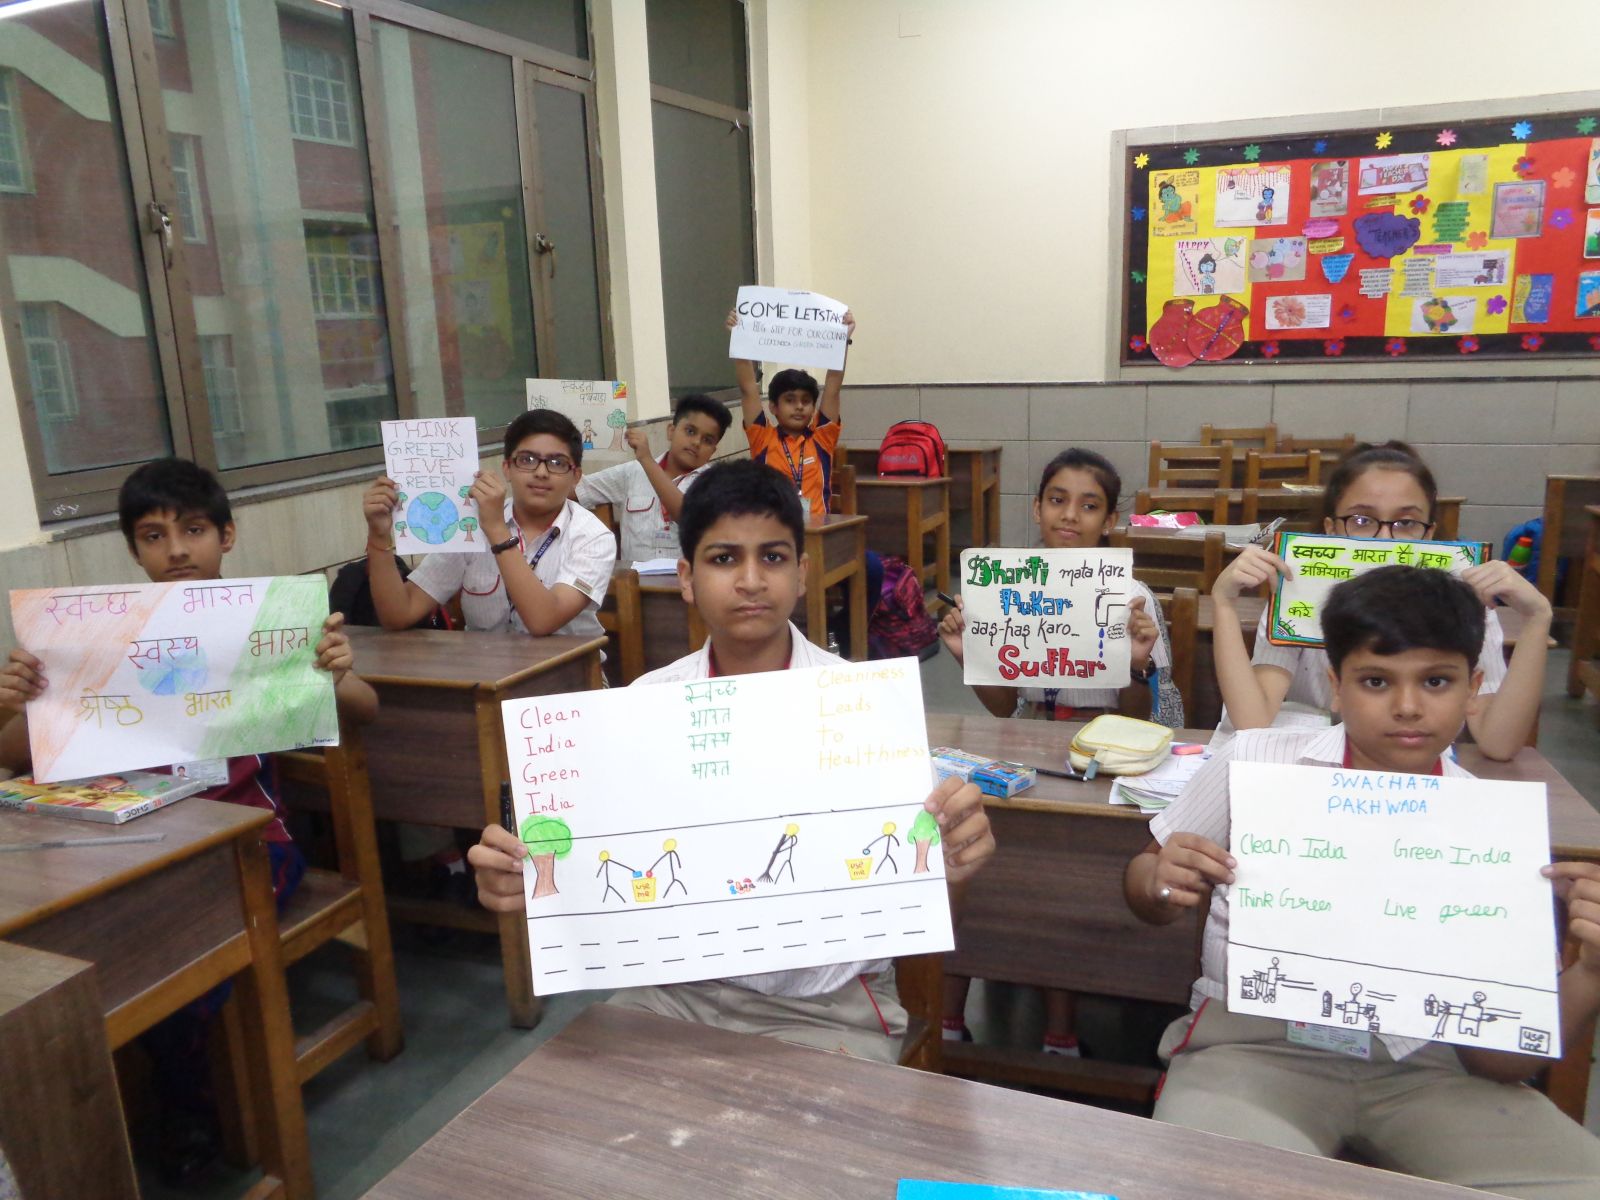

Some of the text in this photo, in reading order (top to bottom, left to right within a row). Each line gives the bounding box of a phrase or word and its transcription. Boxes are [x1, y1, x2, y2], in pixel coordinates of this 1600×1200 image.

[738, 301, 789, 319] COME
[387, 421, 460, 438] THINK
[387, 441, 464, 458] GREEN
[392, 458, 455, 474] LIVE
[1292, 545, 1345, 560] स्वच्छ
[1352, 549, 1393, 563] भारत
[967, 555, 1049, 587] Dharti
[1059, 559, 1094, 587] mata
[45, 585, 253, 625] स्वच्छ भारत
[128, 627, 309, 669] स्वस्थ भारत
[998, 645, 1107, 680] Sudhar
[184, 689, 233, 717] भारत
[817, 693, 871, 718] Leads
[520, 706, 581, 728] Clean
[690, 708, 730, 728] भारत
[524, 733, 576, 756] India
[522, 763, 580, 785] Green
[691, 760, 730, 779] भारत
[1331, 773, 1439, 791] SWACHATA
[525, 792, 575, 815] India
[1240, 833, 1290, 856] Clean
[1394, 838, 1512, 865] Green India
[1238, 887, 1331, 912] Think Green
[1384, 899, 1508, 924] Live green
